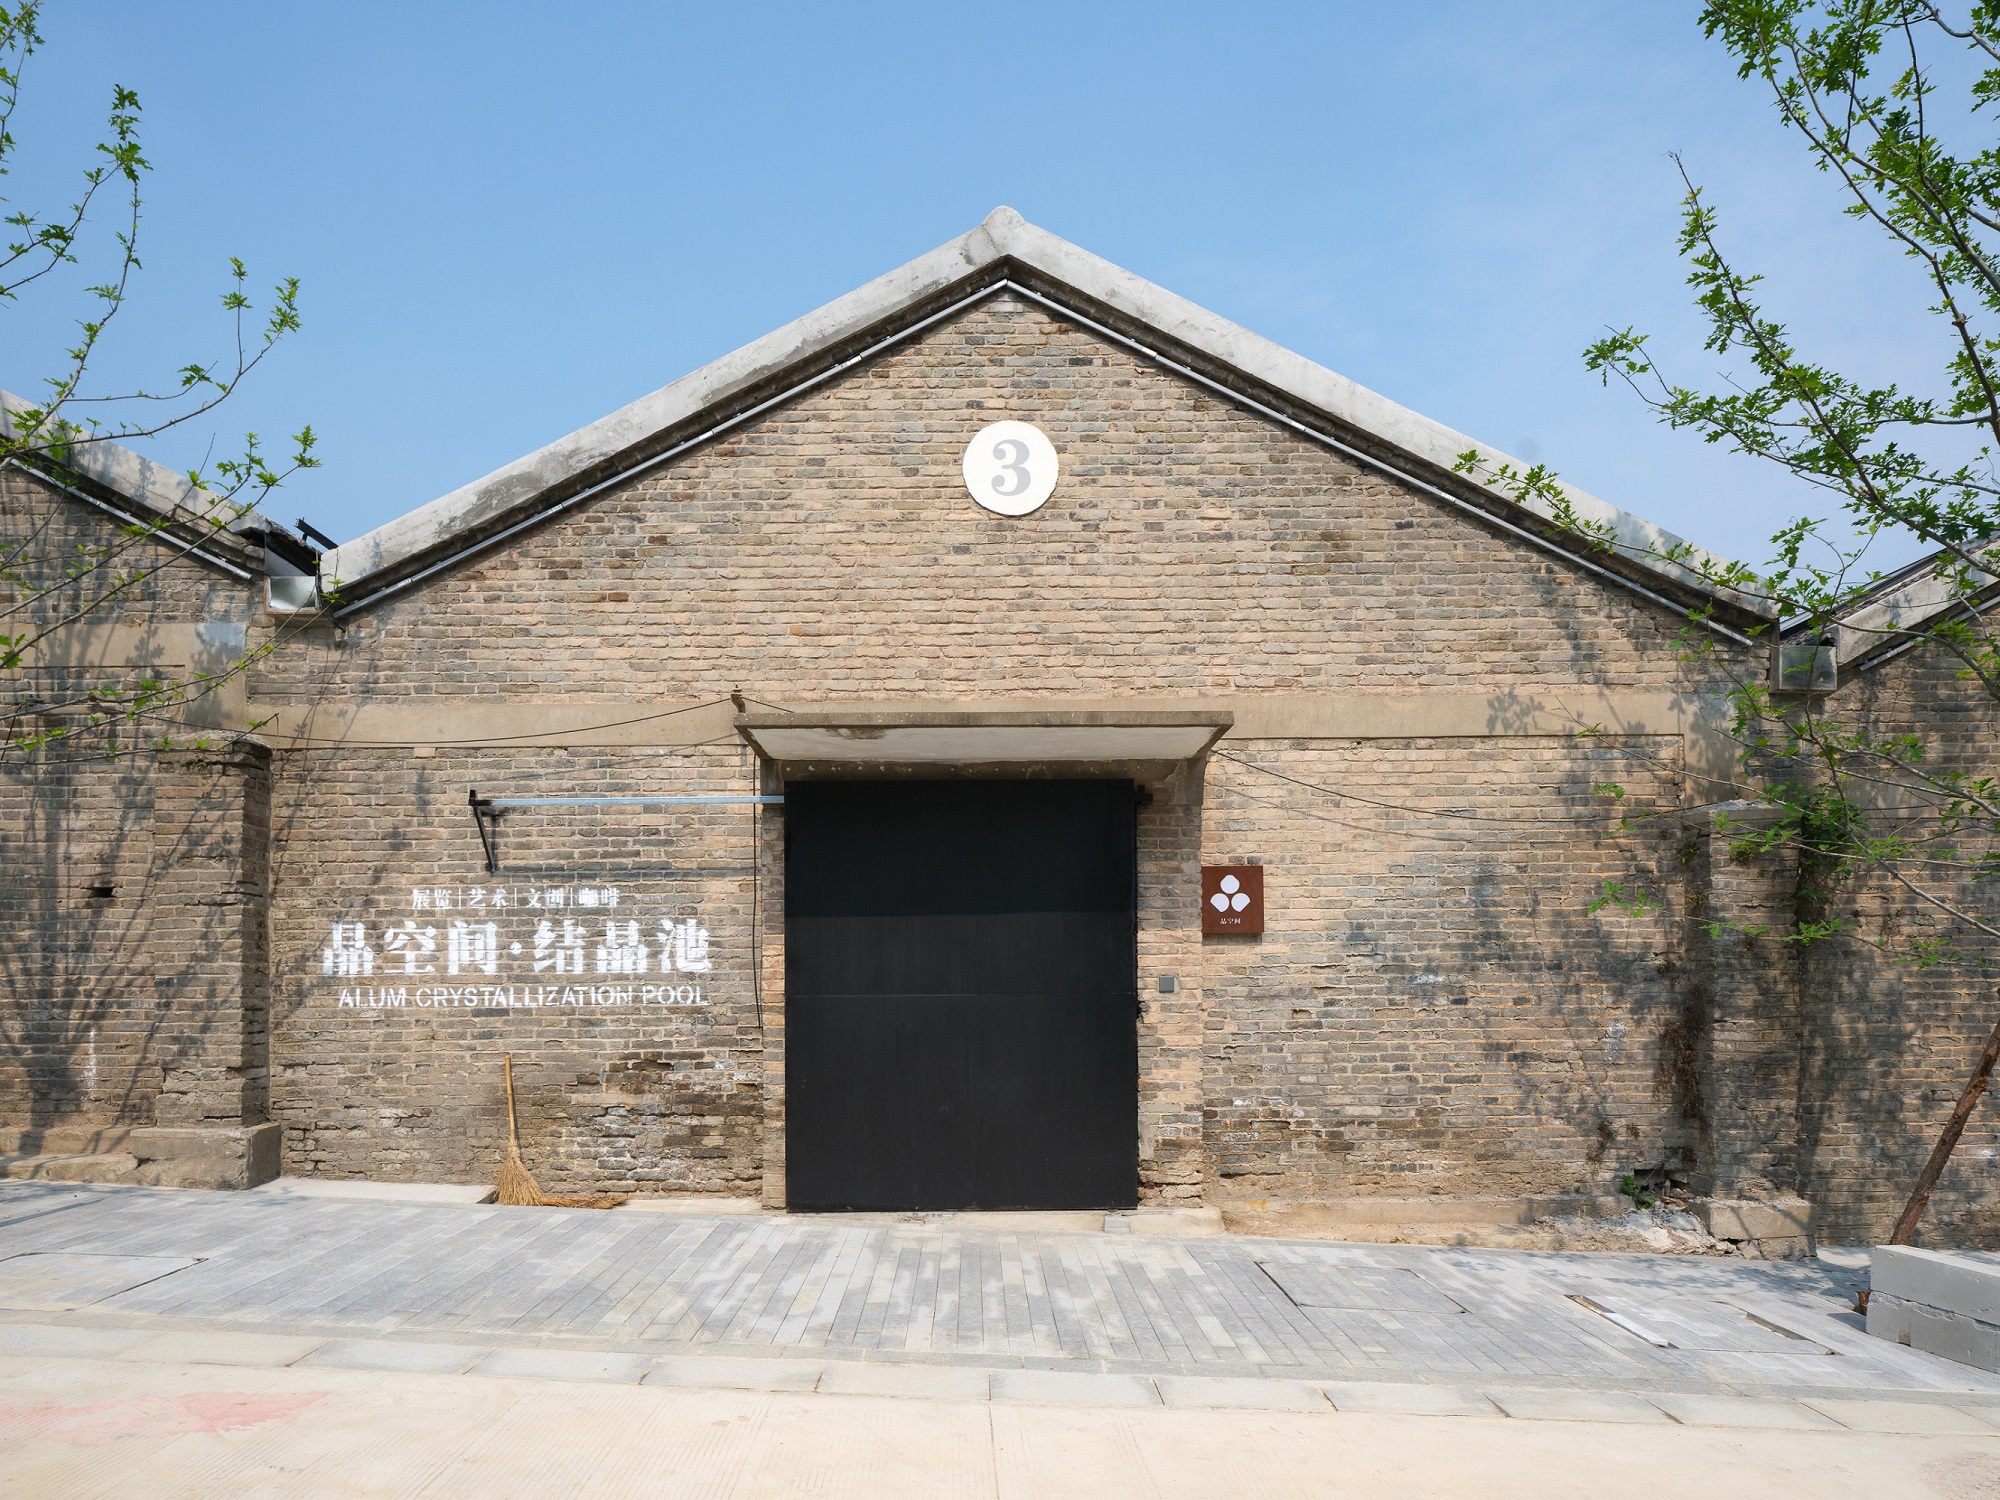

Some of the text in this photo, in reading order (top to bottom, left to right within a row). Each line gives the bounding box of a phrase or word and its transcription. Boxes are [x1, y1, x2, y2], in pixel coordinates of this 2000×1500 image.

[991, 439, 1031, 496] 3
[339, 985, 709, 1008] ALUM CRYSTALLIZATION POOL
